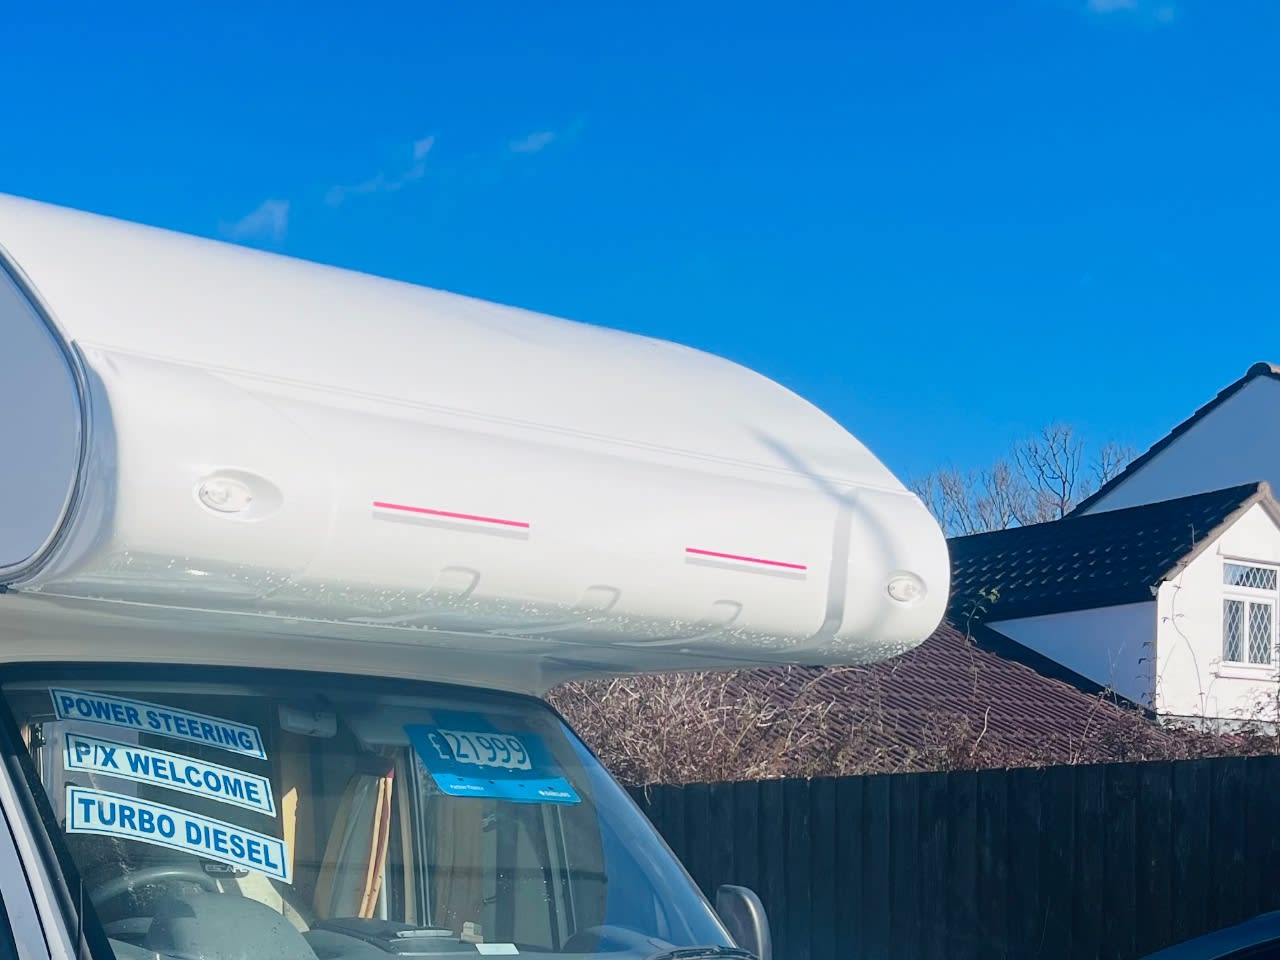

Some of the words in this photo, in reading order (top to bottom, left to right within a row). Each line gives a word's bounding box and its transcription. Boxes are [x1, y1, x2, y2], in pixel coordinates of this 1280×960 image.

[60, 695, 142, 726] POWER
[147, 710, 255, 751] STEERING
[428, 732, 528, 765] £21999
[74, 741, 120, 769] P/X
[127, 751, 263, 804] WELCOME
[77, 798, 176, 839] TURBO
[185, 821, 279, 869] DIESEL
